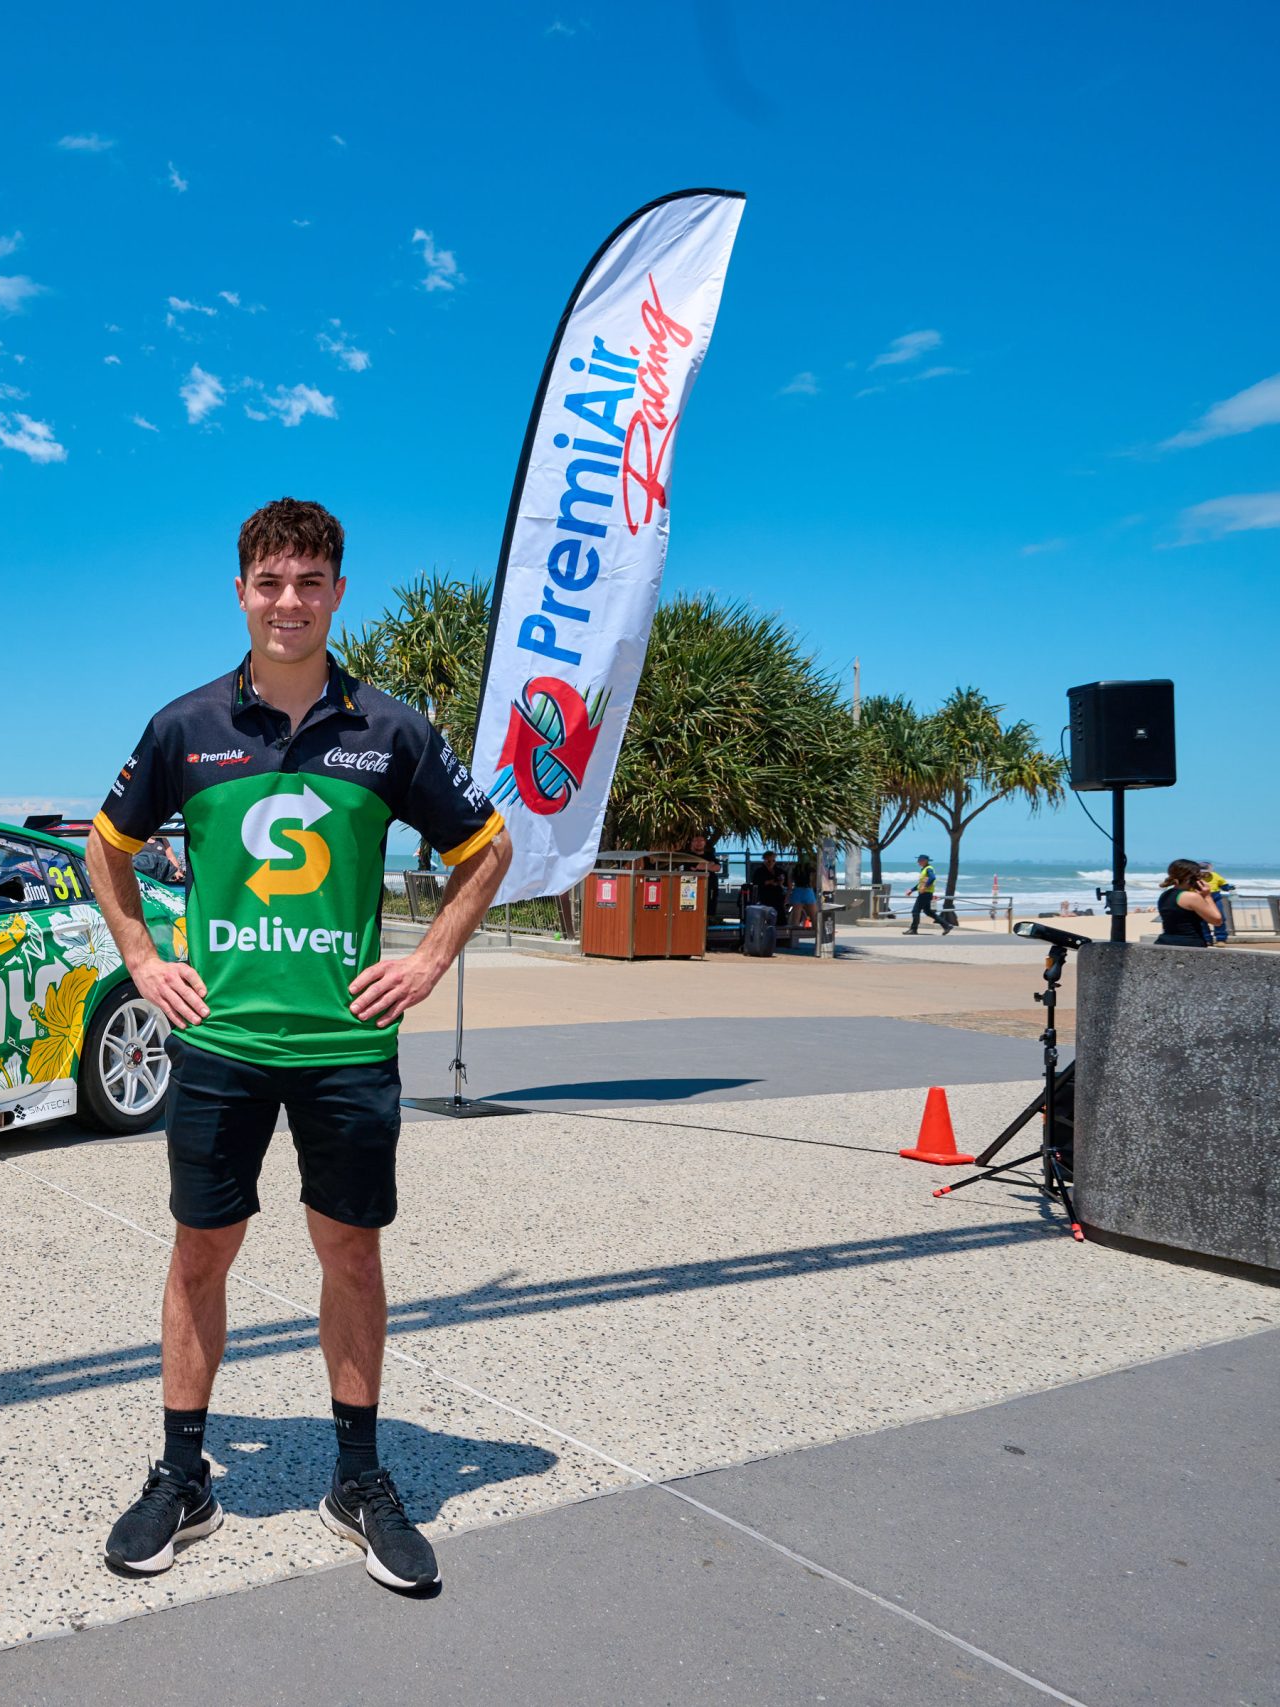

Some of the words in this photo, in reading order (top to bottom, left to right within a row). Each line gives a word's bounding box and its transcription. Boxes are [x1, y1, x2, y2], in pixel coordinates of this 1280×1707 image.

[622, 272, 693, 536] Racing
[517, 335, 641, 666] PremiAir
[200, 749, 245, 763] PremiAir
[48, 865, 82, 901] 31
[209, 916, 358, 967] Delivery
[27, 1098, 70, 1115] SIMTECH
